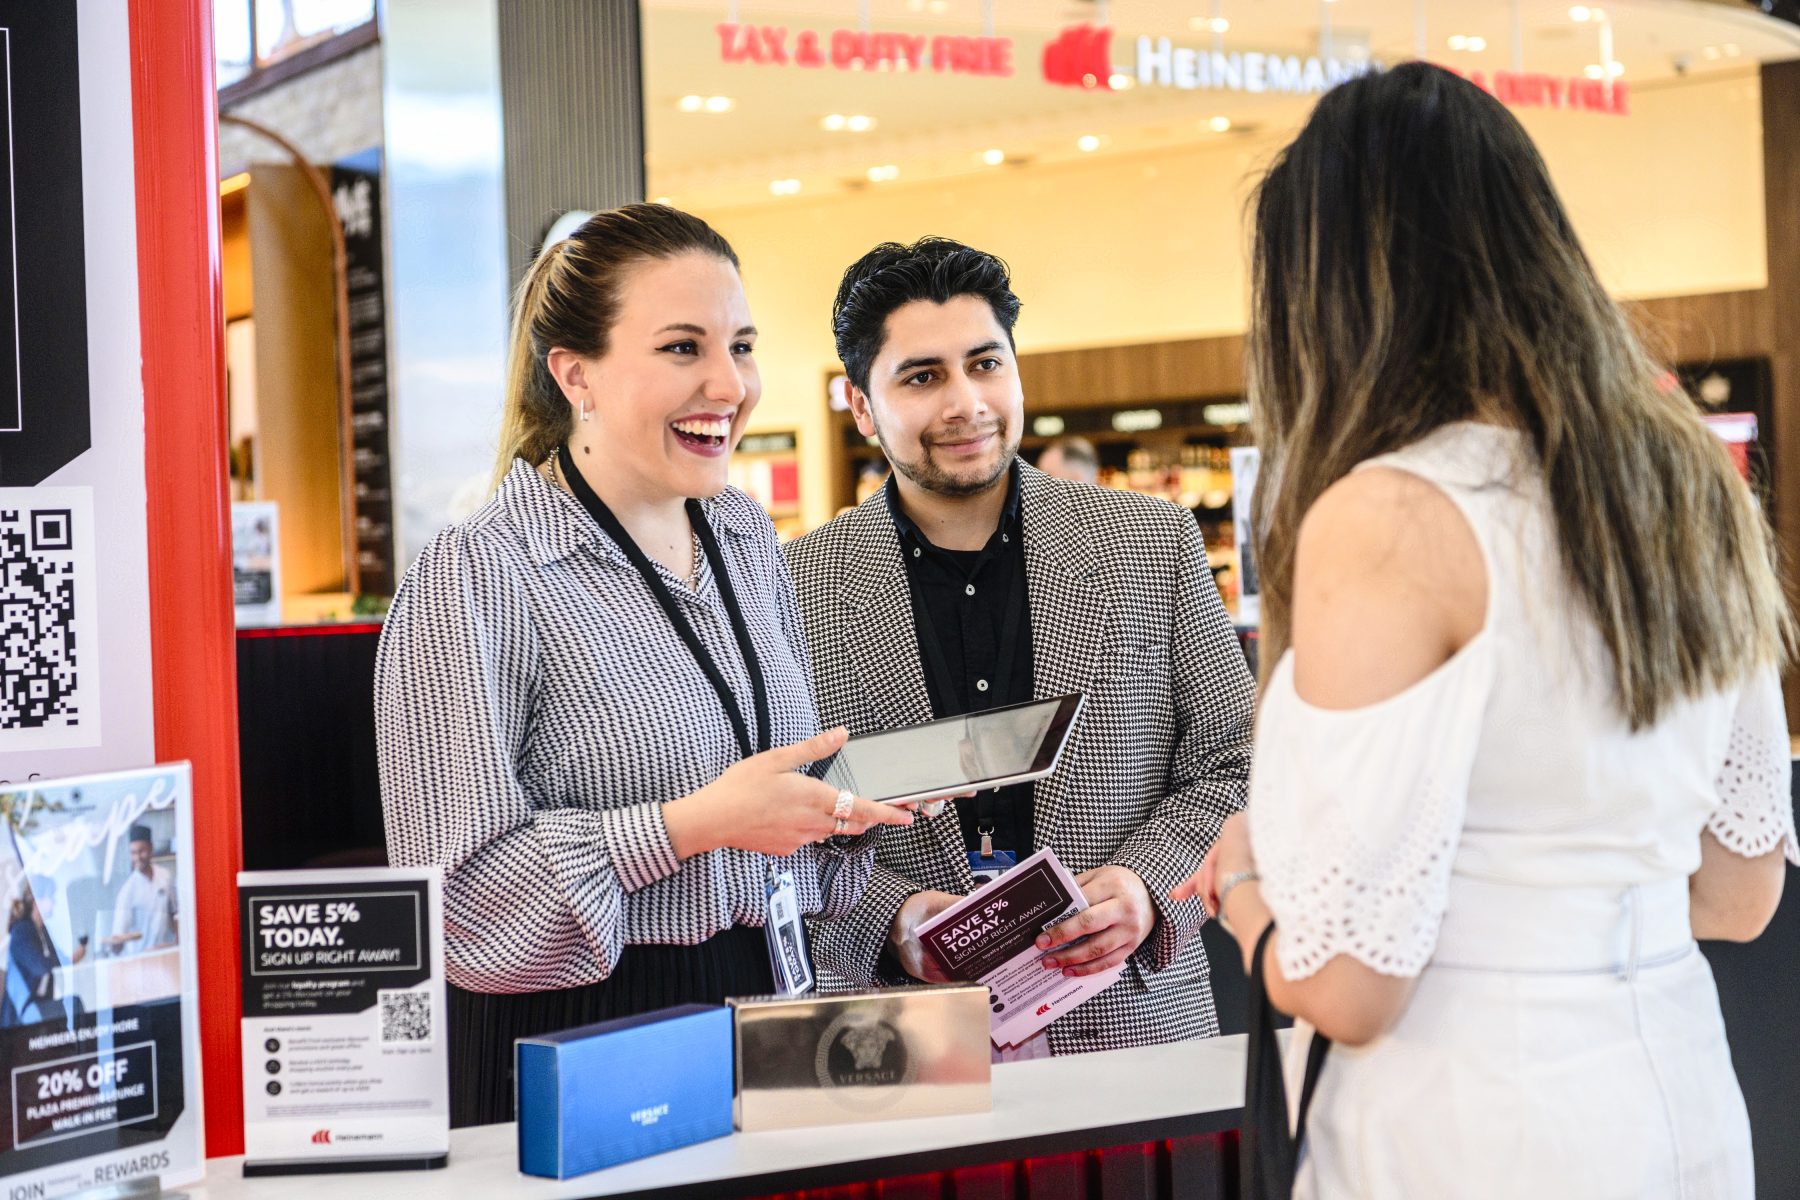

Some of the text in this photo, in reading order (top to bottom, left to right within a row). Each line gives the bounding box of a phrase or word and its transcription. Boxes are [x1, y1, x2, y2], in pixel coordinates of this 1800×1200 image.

[715, 22, 1016, 77] TAX & DUTY FREE
[260, 903, 361, 925] SAVE 5%
[941, 914, 982, 945] SAVE
[984, 899, 1009, 918] 5%
[260, 926, 344, 948] TODAY.
[947, 915, 1004, 953] TODAY.
[955, 946, 976, 962] SIGN
[976, 937, 989, 948] UP
[990, 919, 1017, 939] RIGHT
[1019, 900, 1047, 922] AWAY!
[261, 952, 292, 966] SIGN
[295, 951, 314, 965] UP
[316, 950, 354, 964] RIGHT
[982, 946, 1000, 960] loyalty
[1000, 934, 1021, 949] program
[1052, 985, 1084, 1006] Heinemann
[37, 1058, 129, 1099] 20% OFF
[94, 1150, 170, 1184] REWARDS
[9, 1180, 45, 1200] JOIN
